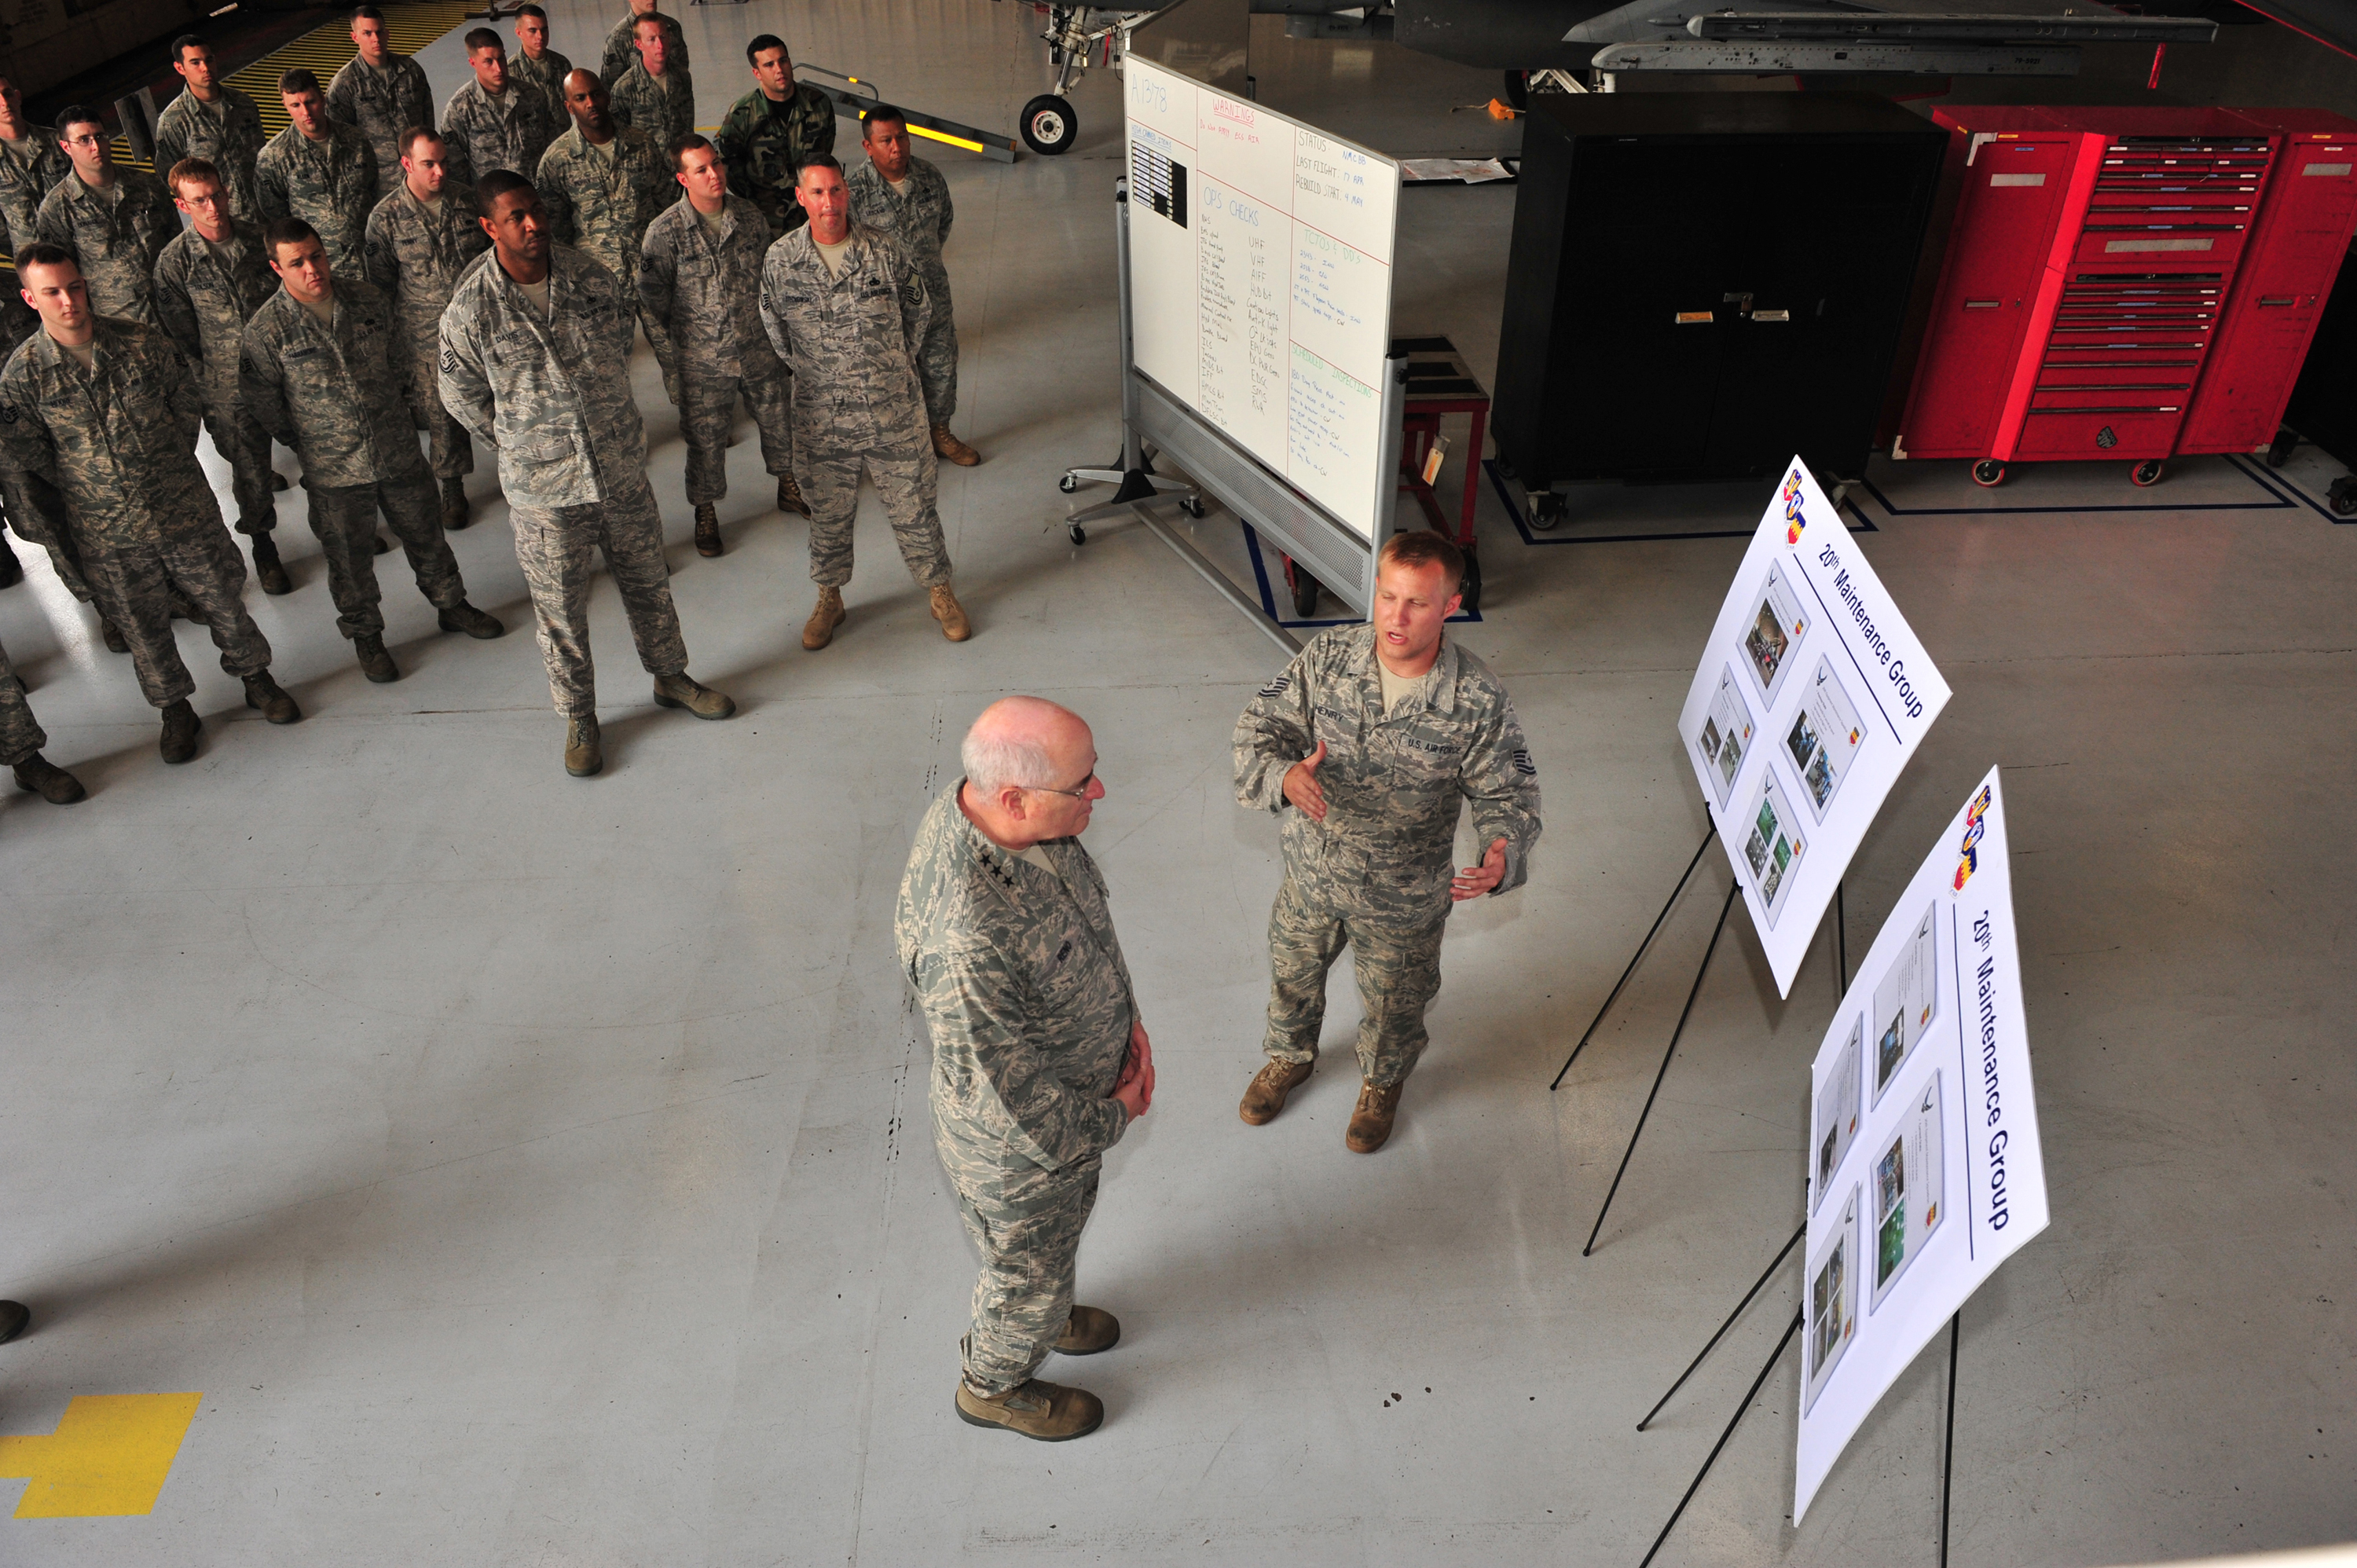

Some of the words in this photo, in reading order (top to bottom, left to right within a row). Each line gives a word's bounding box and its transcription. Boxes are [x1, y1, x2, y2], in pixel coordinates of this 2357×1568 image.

[1213, 99, 1254, 123] WARNINGS
[1248, 134, 1259, 144] AIR
[1296, 156, 1312, 170] LAST
[1353, 175, 1364, 185] APR
[1296, 174, 1321, 194] REBUILD
[1351, 196, 1362, 207] MAY
[1230, 200, 1259, 226] CHECKS
[1249, 236, 1265, 250] UHF
[1250, 251, 1265, 267] VHF
[1251, 269, 1266, 283] AIFF
[1250, 282, 1262, 298] HUD
[496, 332, 519, 343] DAVIS
[1251, 340, 1262, 355] EPU
[1201, 366, 1214, 379] IFF
[1292, 343, 1323, 370] SCHEDULED
[1332, 368, 1372, 398] INSPECTIONS
[1819, 544, 1840, 570] 20th
[1834, 569, 1890, 665] Maintenance
[1889, 661, 1923, 718] Group
[1315, 704, 1343, 722] HENRY
[1408, 738, 1422, 751] U.S.
[1424, 742, 1439, 754] AIR
[1439, 744, 1462, 755] FORCE
[1974, 910, 1992, 952] 20th
[1057, 940, 1072, 963] RENO
[1978, 956, 2001, 1127] Maintenance
[1989, 1130, 2009, 1231] Group
